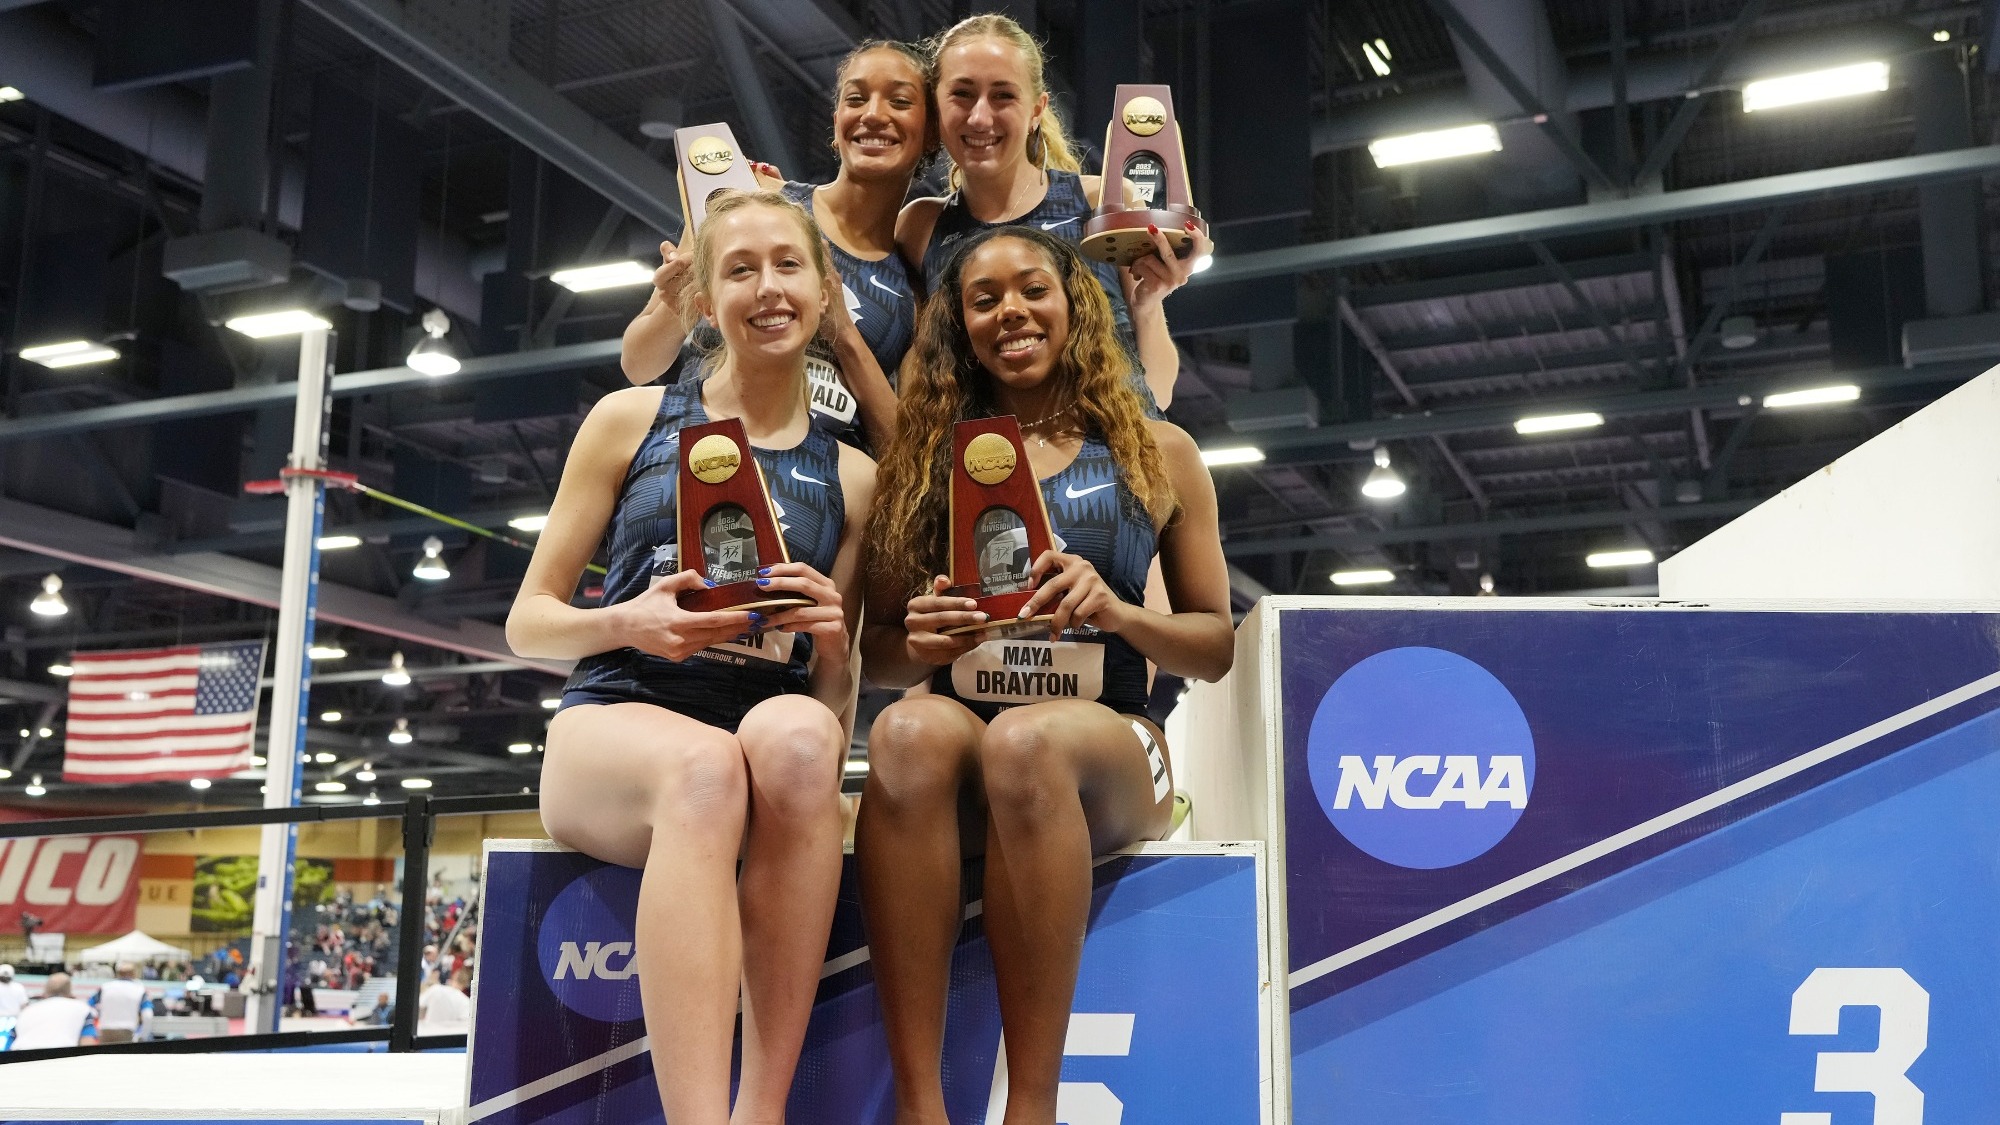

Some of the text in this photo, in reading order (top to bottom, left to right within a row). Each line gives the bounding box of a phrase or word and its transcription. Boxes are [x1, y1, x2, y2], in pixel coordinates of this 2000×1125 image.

[1127, 114, 1164, 125] NCAA
[694, 453, 738, 474] NCAA
[969, 455, 1015, 473] NCAA
[711, 522, 740, 533] DIVISION
[982, 522, 1011, 533] DIVISION
[1003, 646, 1053, 666] MAYA
[976, 670, 1078, 697] DRAYTON
[1333, 755, 1528, 809] NCAA
[0, 836, 139, 906] ICO
[553, 941, 640, 980] NC
